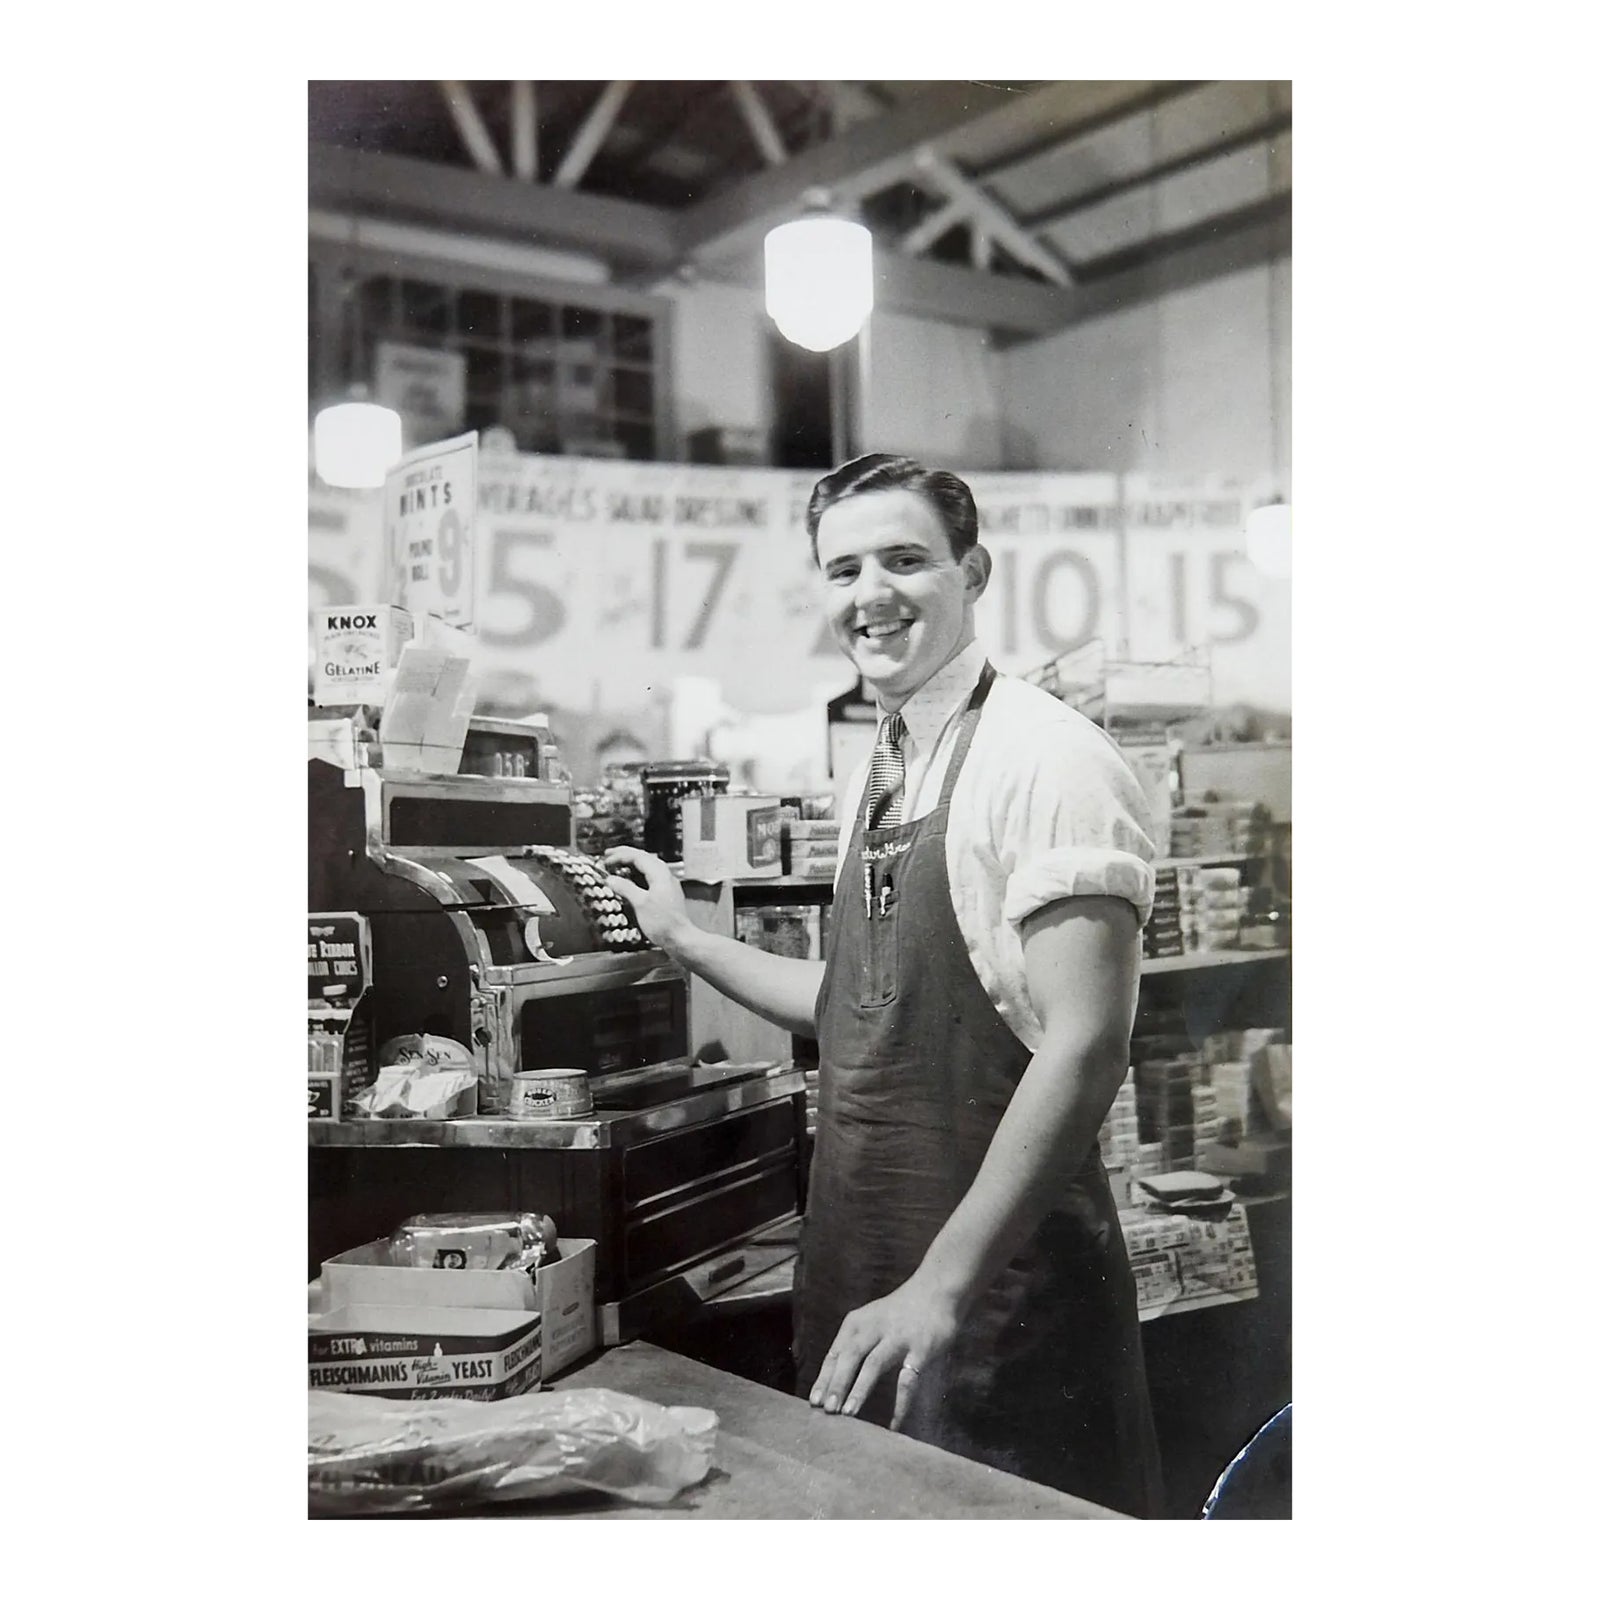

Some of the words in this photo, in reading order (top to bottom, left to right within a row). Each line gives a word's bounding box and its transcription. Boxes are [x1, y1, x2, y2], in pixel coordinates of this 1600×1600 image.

[401, 482, 452, 517] MINTS
[479, 530, 566, 649] 5
[653, 538, 742, 649] 17
[1003, 549, 1100, 655] 10
[1171, 552, 1259, 645] 15
[328, 615, 376, 630] KNOX
[325, 661, 381, 677] GELATINE
[331, 1338, 367, 1355] EXTRA
[370, 1337, 418, 1352] vitamins
[310, 1361, 408, 1387] FLEISCHMANN'S
[452, 1360, 493, 1380] YEAST
